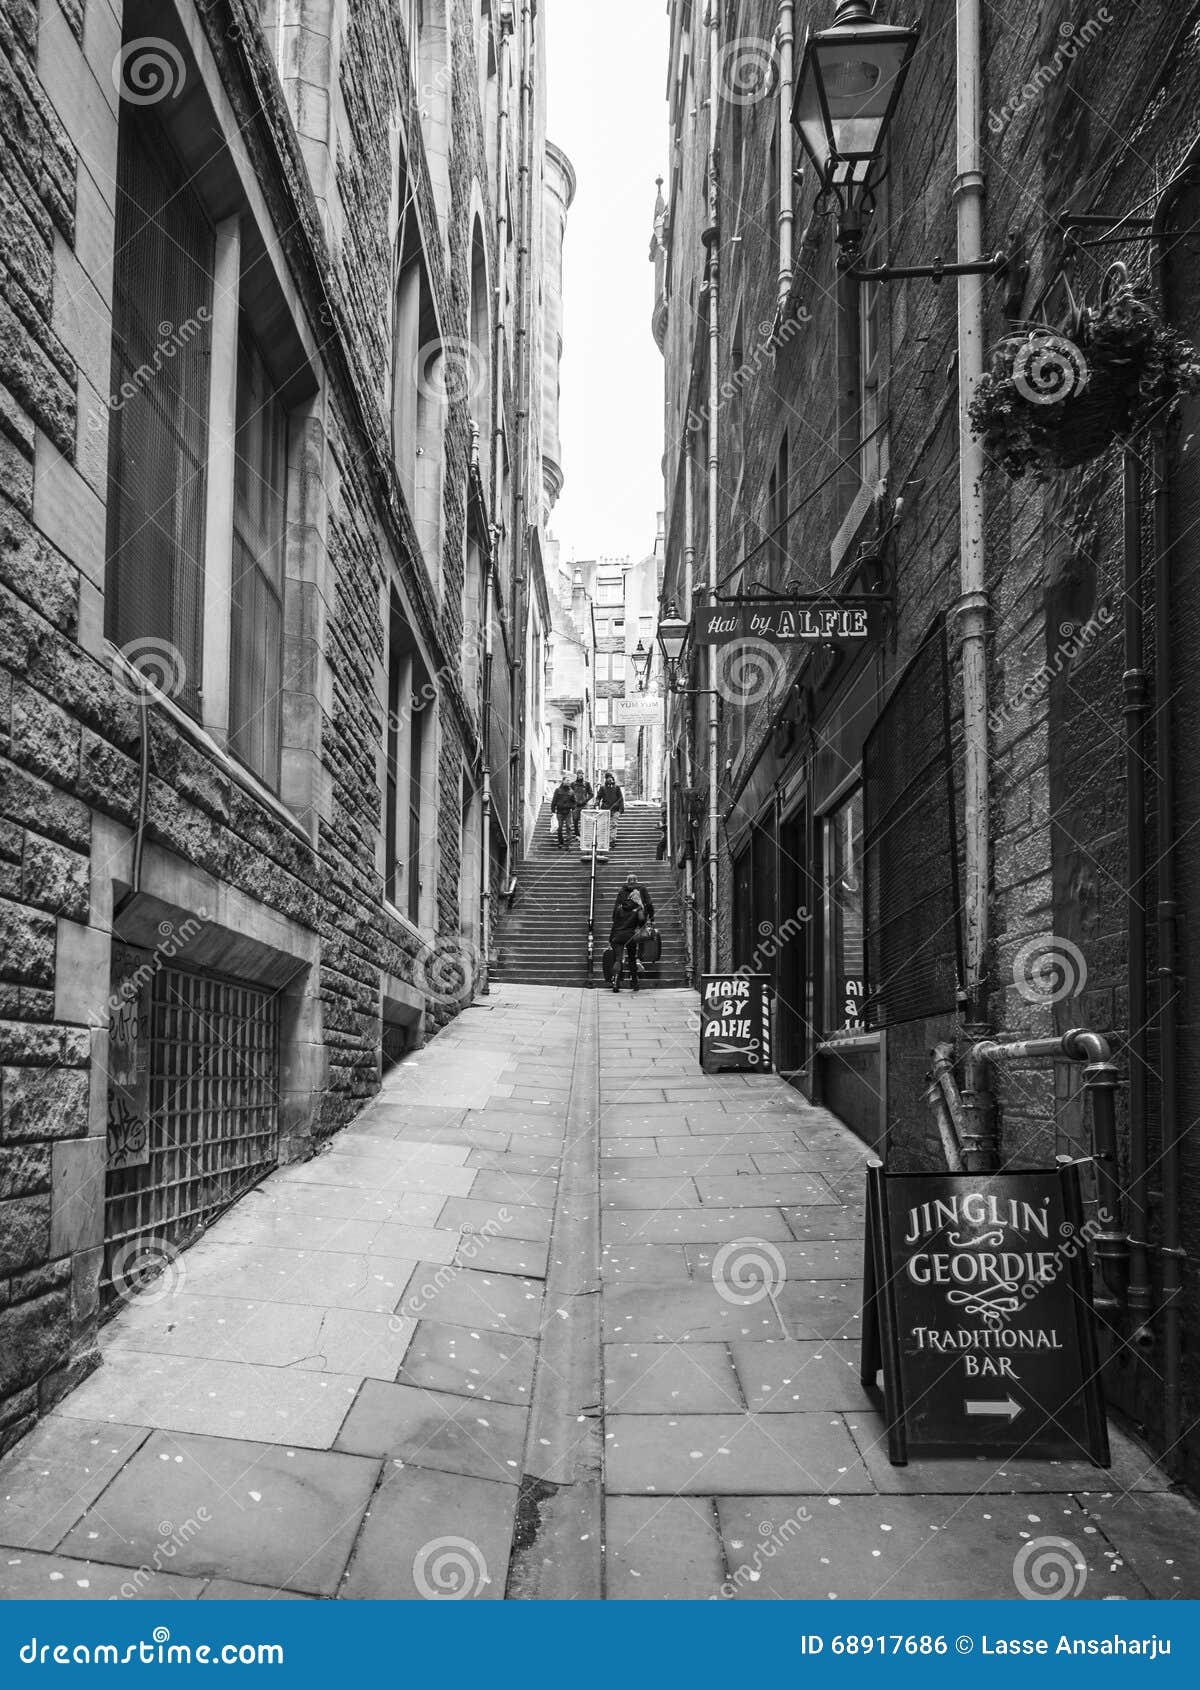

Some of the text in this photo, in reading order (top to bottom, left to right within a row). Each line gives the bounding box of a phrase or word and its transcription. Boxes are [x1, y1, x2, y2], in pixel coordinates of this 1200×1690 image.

[751, 614, 774, 635] by
[776, 610, 868, 637] ALFIE
[705, 981, 750, 1000] HAIR
[722, 1000, 749, 1016] BY
[705, 1020, 751, 1038] ALFIE
[906, 1193, 1050, 1241] JINGLIN'
[908, 1252, 1056, 1284] GEORDIE
